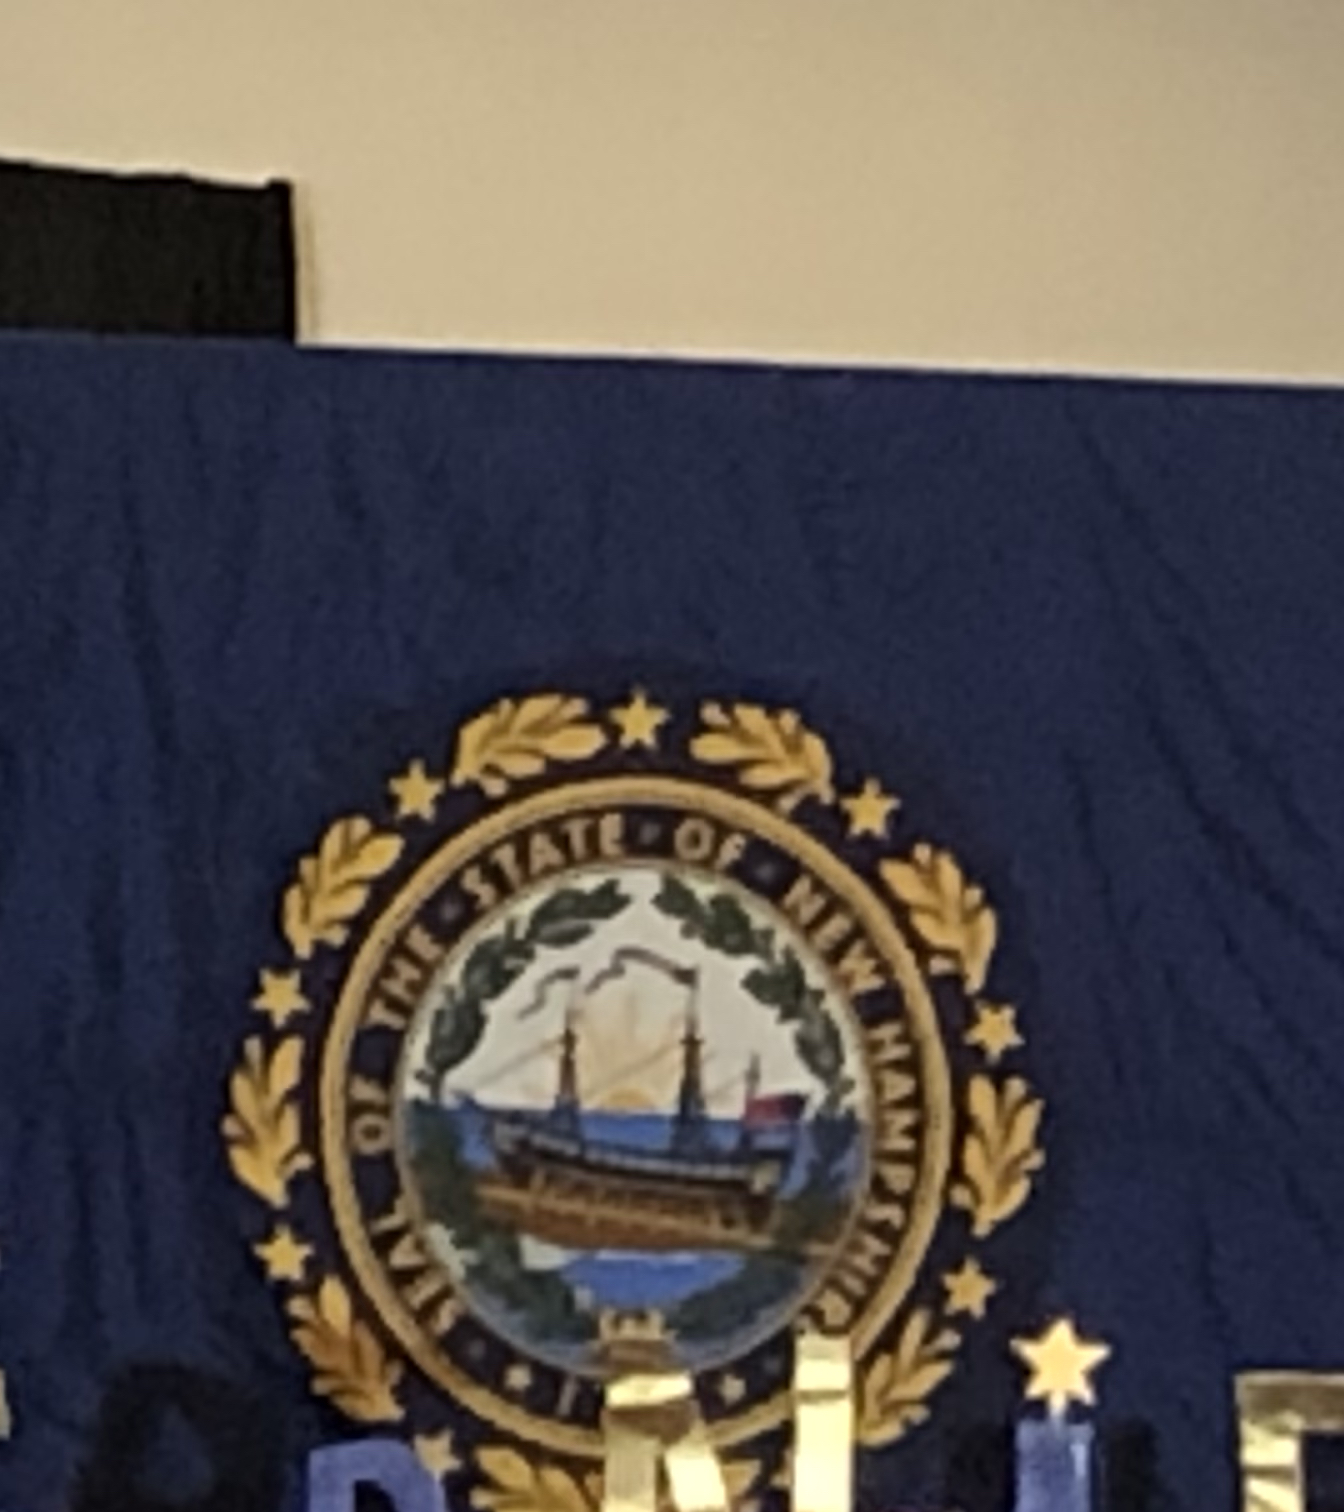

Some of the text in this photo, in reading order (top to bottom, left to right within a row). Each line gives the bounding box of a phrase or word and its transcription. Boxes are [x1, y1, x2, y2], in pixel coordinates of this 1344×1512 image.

[460, 813, 626, 908] STATE
[673, 815, 749, 872] OF
[367, 925, 444, 1031] THE
[781, 874, 888, 996] NEW
[794, 1020, 916, 1335] HAMPSHIR
